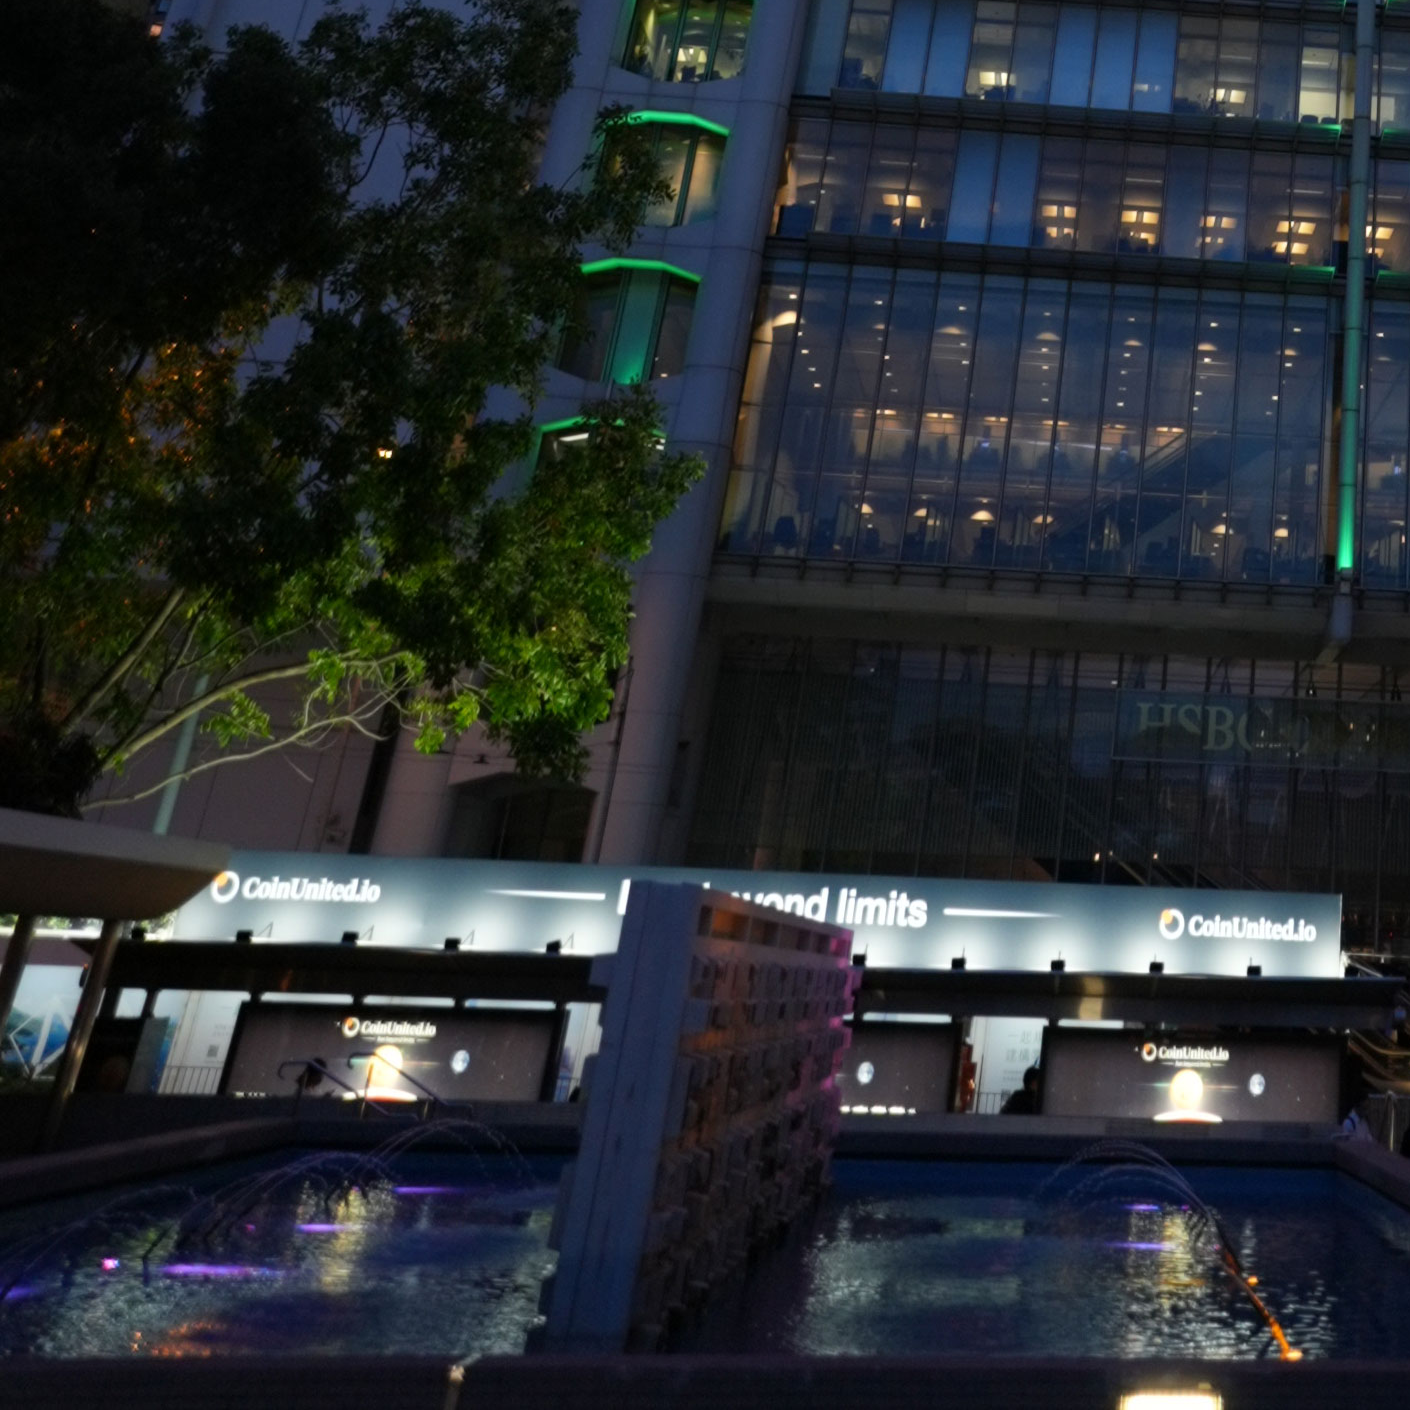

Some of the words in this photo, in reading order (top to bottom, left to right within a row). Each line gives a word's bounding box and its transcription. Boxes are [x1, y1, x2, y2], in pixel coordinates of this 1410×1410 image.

[242, 876, 381, 902] CoinUnited.io
[836, 887, 928, 928] limits
[1188, 915, 1317, 941] CoinUnited.io
[361, 1020, 436, 1037] CoinUnited.io
[1159, 1046, 1229, 1061] CoinUnited.io
